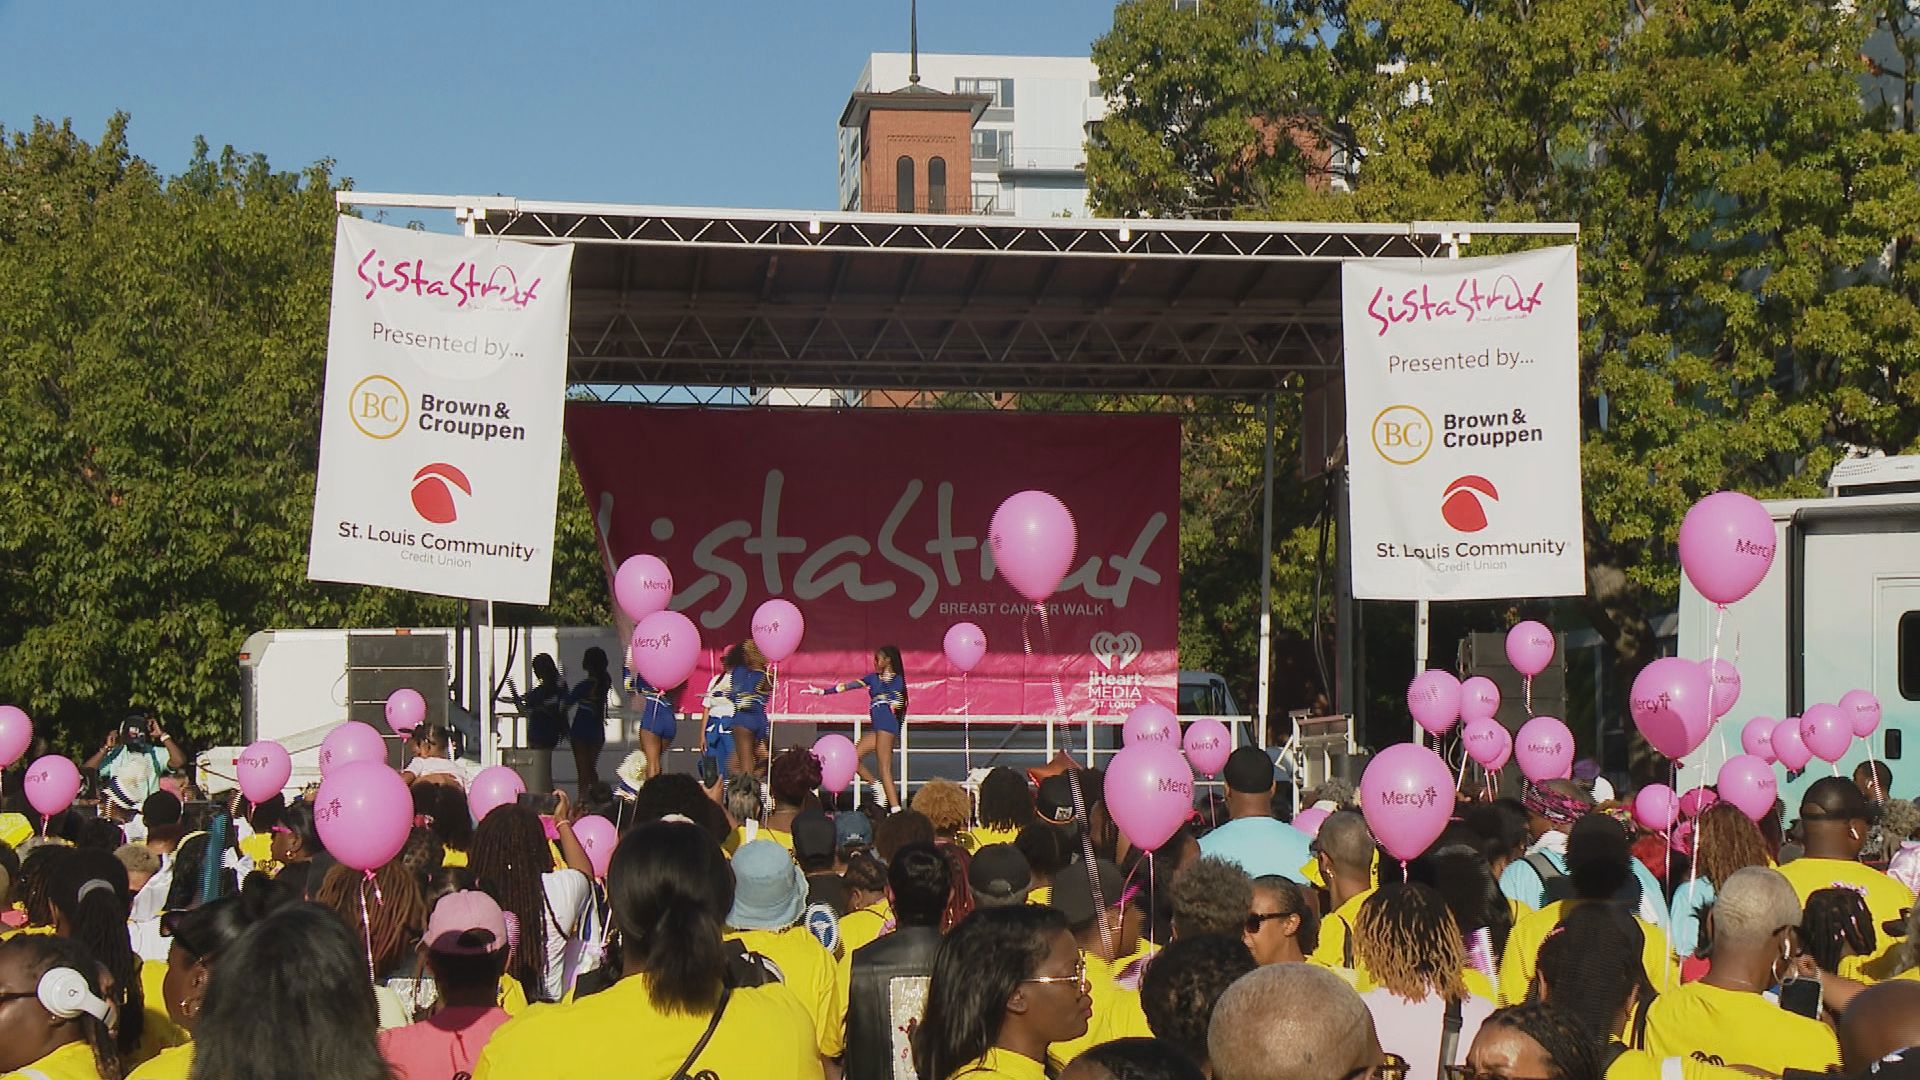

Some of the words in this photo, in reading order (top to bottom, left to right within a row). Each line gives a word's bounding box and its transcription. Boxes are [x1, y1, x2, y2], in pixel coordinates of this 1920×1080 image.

[1368, 274, 1544, 336] SistaStrut
[373, 322, 477, 354] Presented
[484, 337, 524, 360] by...
[1389, 349, 1489, 374] Presented
[1497, 348, 1534, 370] by...
[360, 392, 400, 423] BC
[419, 413, 526, 442] Crouppen
[1383, 422, 1423, 447] BC
[1443, 428, 1543, 448] Crouppen
[338, 521, 363, 539] St.
[368, 524, 416, 546] Louis
[421, 532, 536, 562] Community
[1376, 542, 1400, 558] St.
[1403, 543, 1450, 560] Louis
[1455, 539, 1567, 557] Community
[400, 550, 434, 566] Credit
[437, 555, 473, 570] Union
[1437, 560, 1470, 573] Credit
[1473, 560, 1508, 571] Union
[939, 602, 997, 615] BREAST
[1000, 603, 1059, 616] CANCR
[1063, 603, 1104, 616] WALK
[1088, 670, 1144, 686] iHeart
[1088, 685, 1142, 699] MEDIA
[1109, 700, 1137, 710] LOUIS
[1528, 743, 1554, 756] Mercy
[1382, 790, 1425, 809] Mercy
